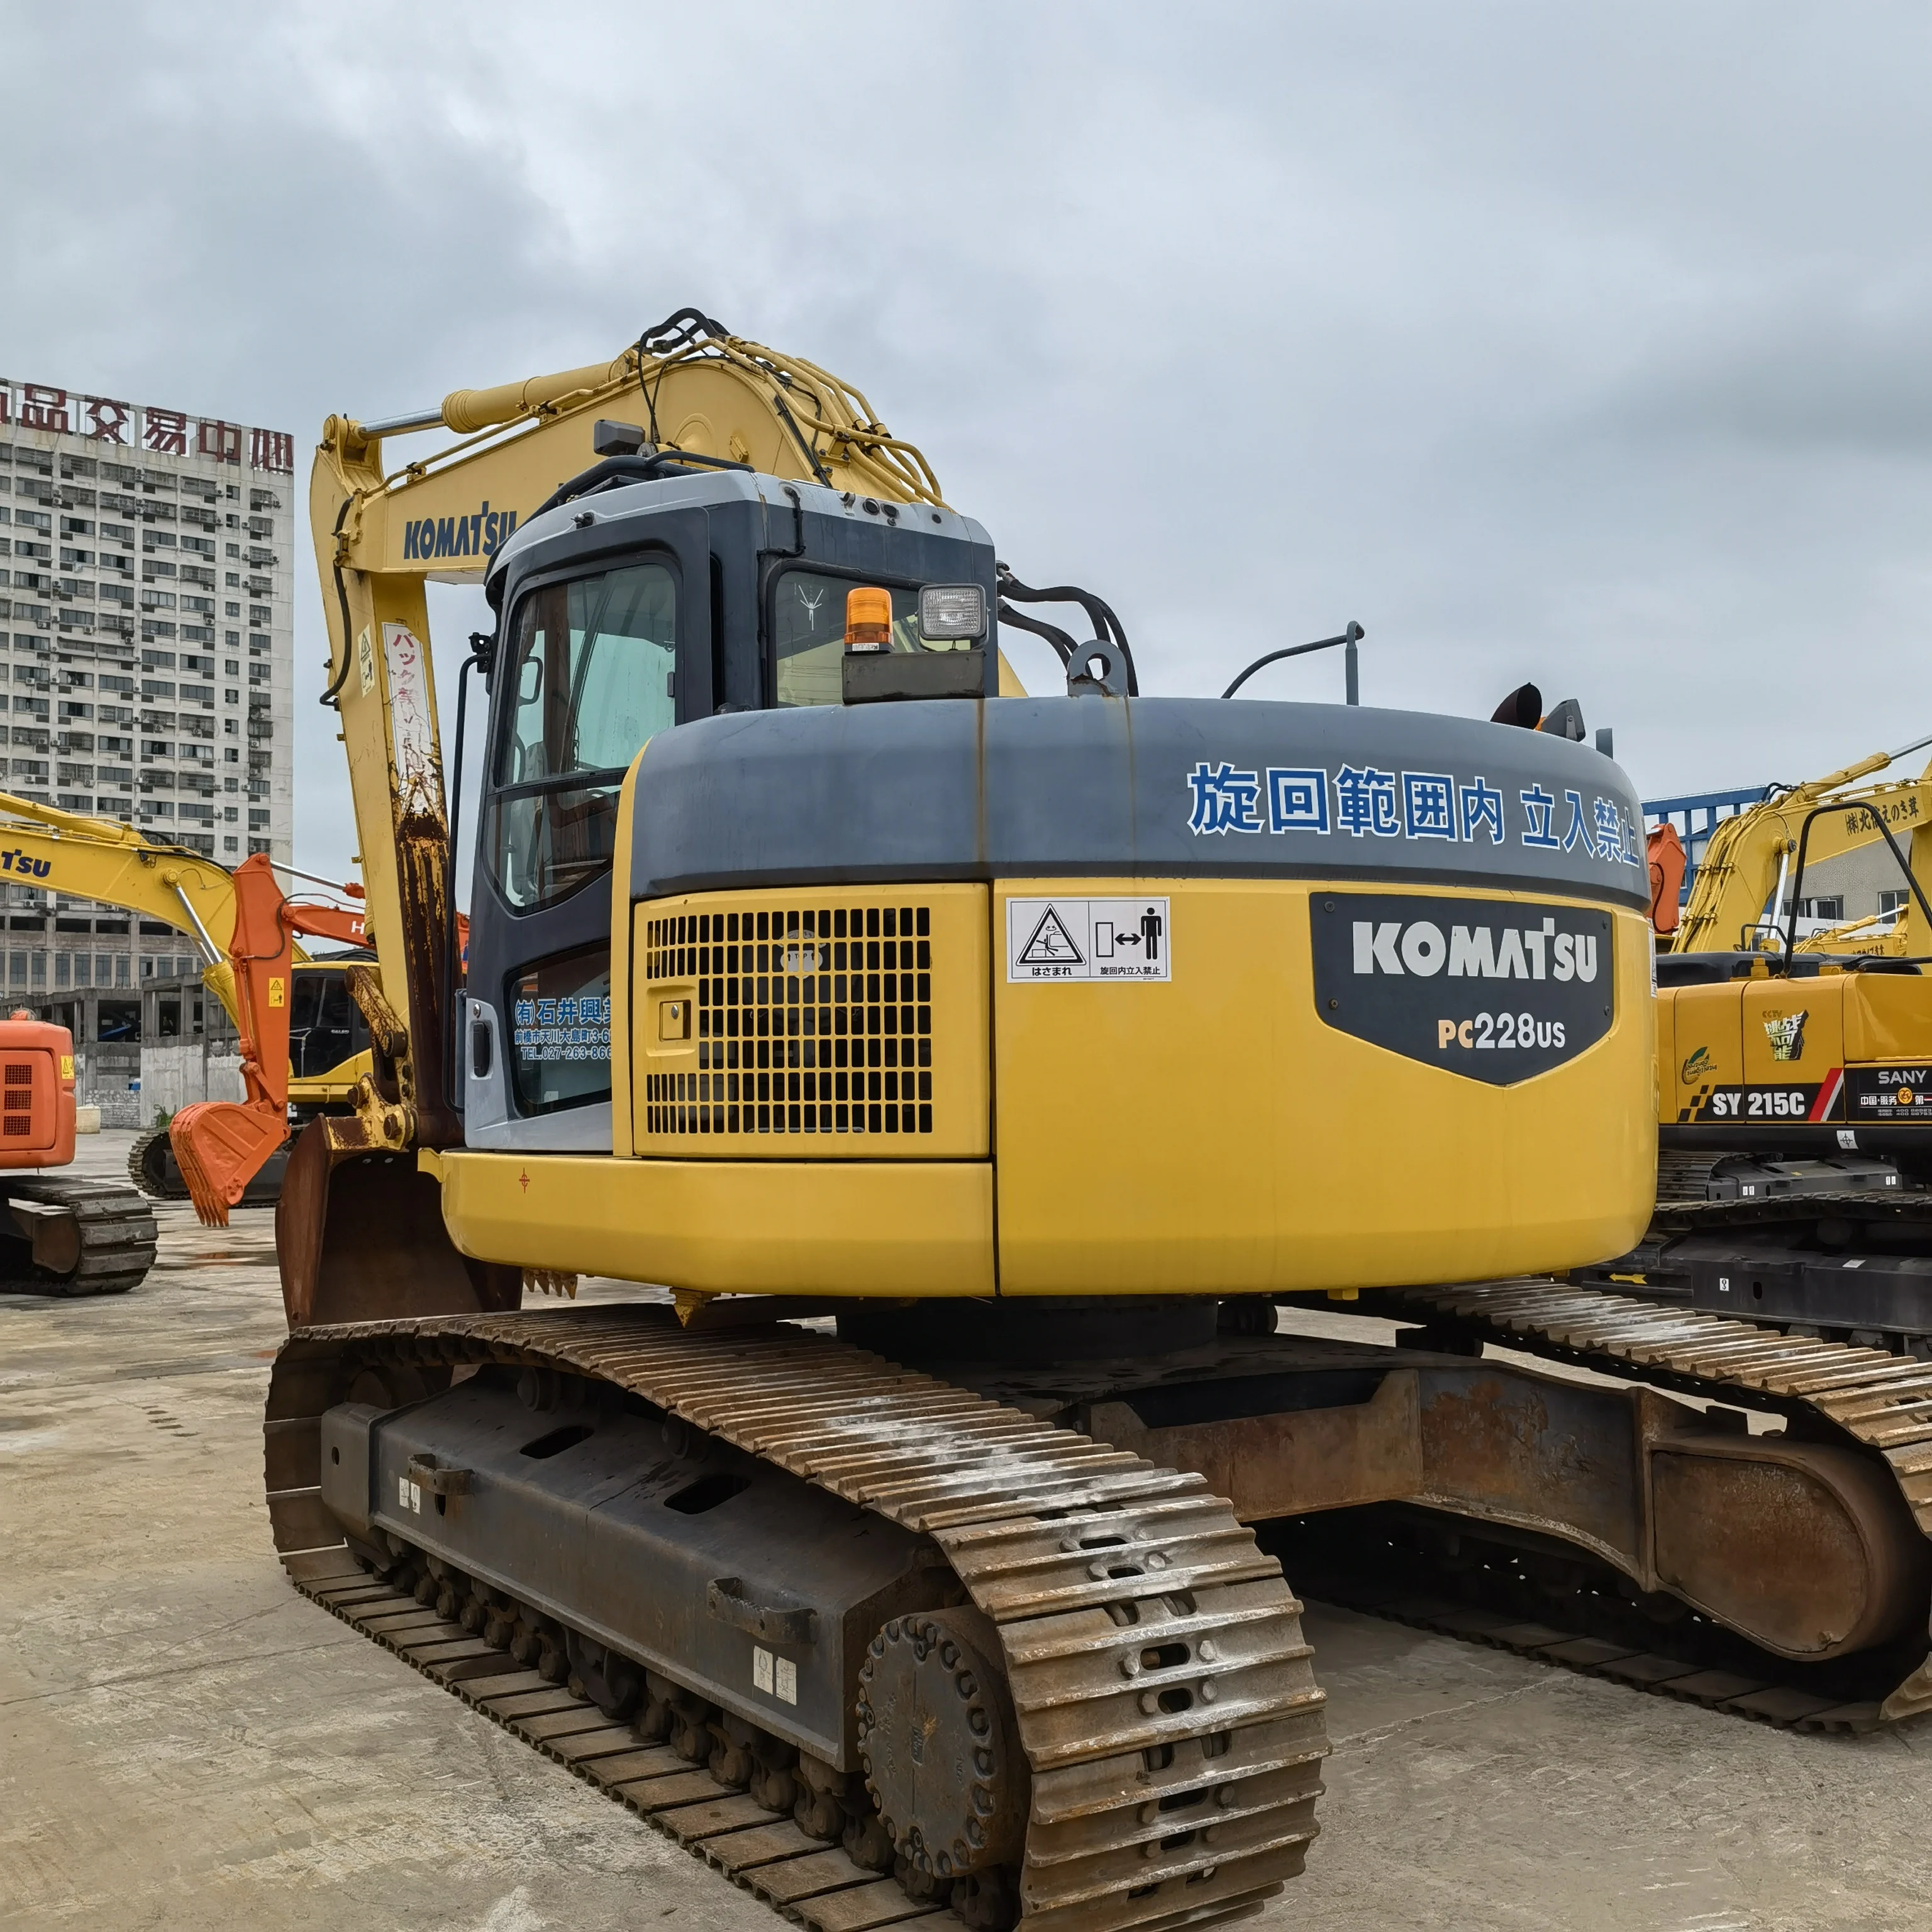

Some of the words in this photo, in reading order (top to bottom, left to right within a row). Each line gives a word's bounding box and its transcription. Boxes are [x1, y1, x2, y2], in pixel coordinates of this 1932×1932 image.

[404, 501, 517, 560] KOMATSU
[1187, 761, 1505, 845] 旋回範囲内
[1519, 782, 1640, 869] 立入禁止
[1353, 918, 1597, 983] KOMATSU
[1032, 967, 1072, 977] はさまれ
[1100, 966, 1161, 975] 旋回内立入禁止
[514, 1028, 611, 1045] 前橋市天川大島町3-6
[1438, 1012, 1566, 1050] PC228US
[1878, 1070, 1927, 1084] SANY
[1713, 1092, 1741, 1116] SY
[1748, 1092, 1806, 1116] 215C
